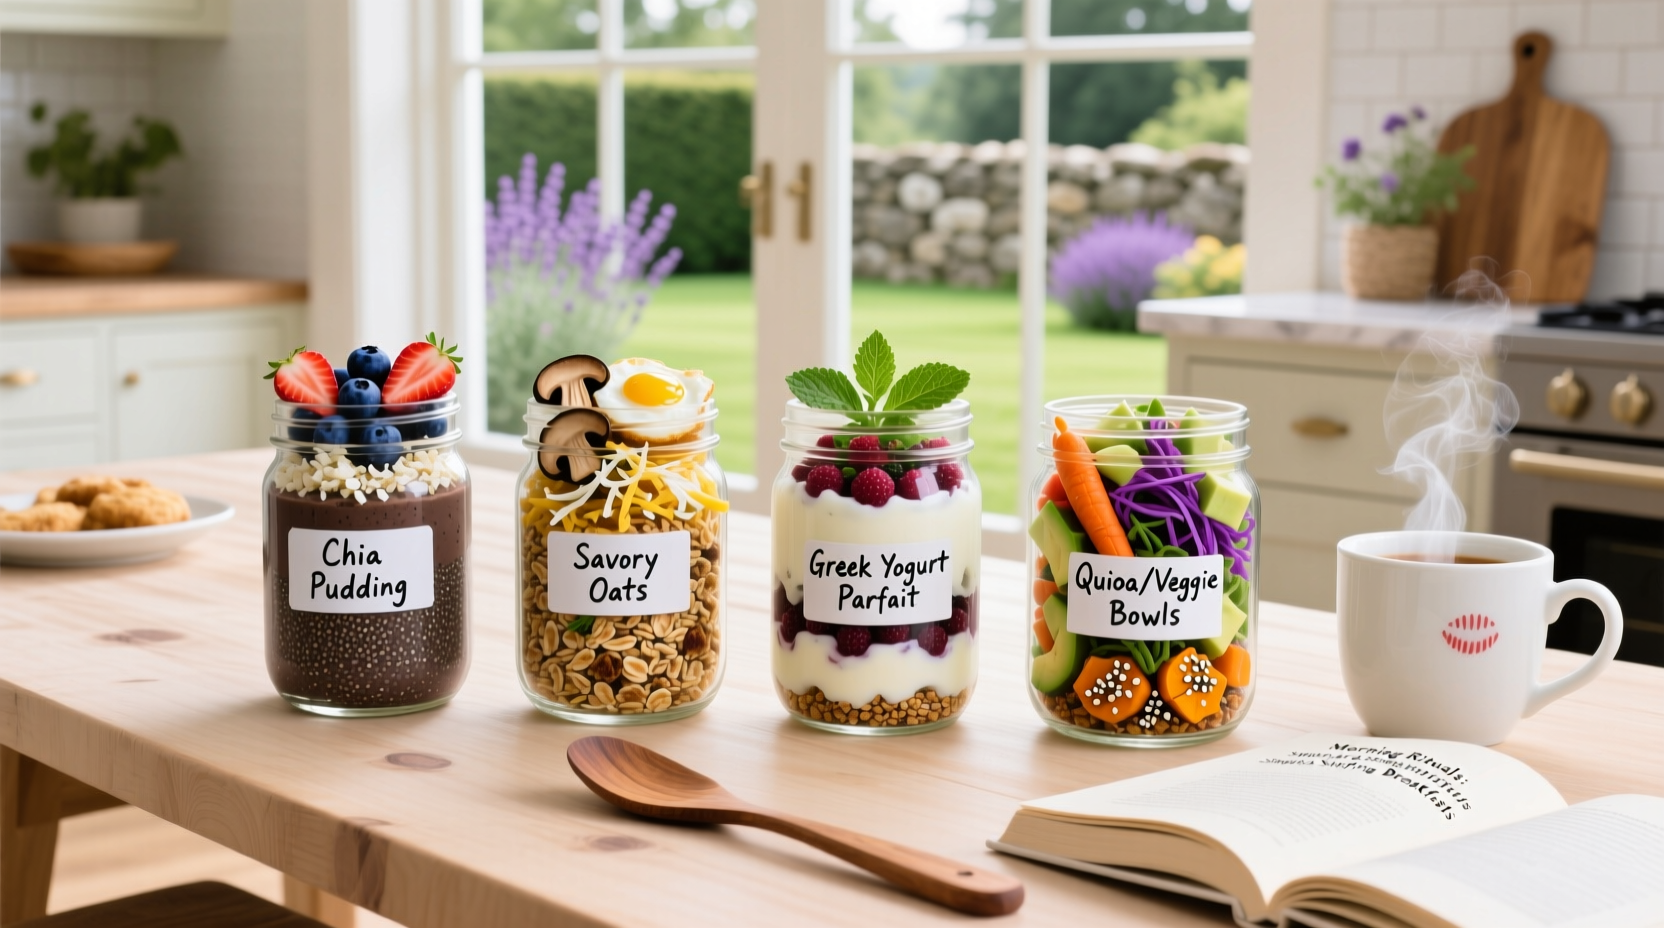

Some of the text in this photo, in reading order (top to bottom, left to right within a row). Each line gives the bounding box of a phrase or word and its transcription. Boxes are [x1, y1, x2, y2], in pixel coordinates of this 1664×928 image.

[322, 538, 382, 566] Chia
[574, 542, 658, 580] Savory
[809, 549, 950, 586] Greek Yogurt
[310, 571, 407, 607] Pudding
[589, 577, 648, 603] Oats
[1076, 562, 1218, 601] Quioa/Veggie
[838, 584, 920, 614] Parfait
[1109, 600, 1180, 627] Bowls
